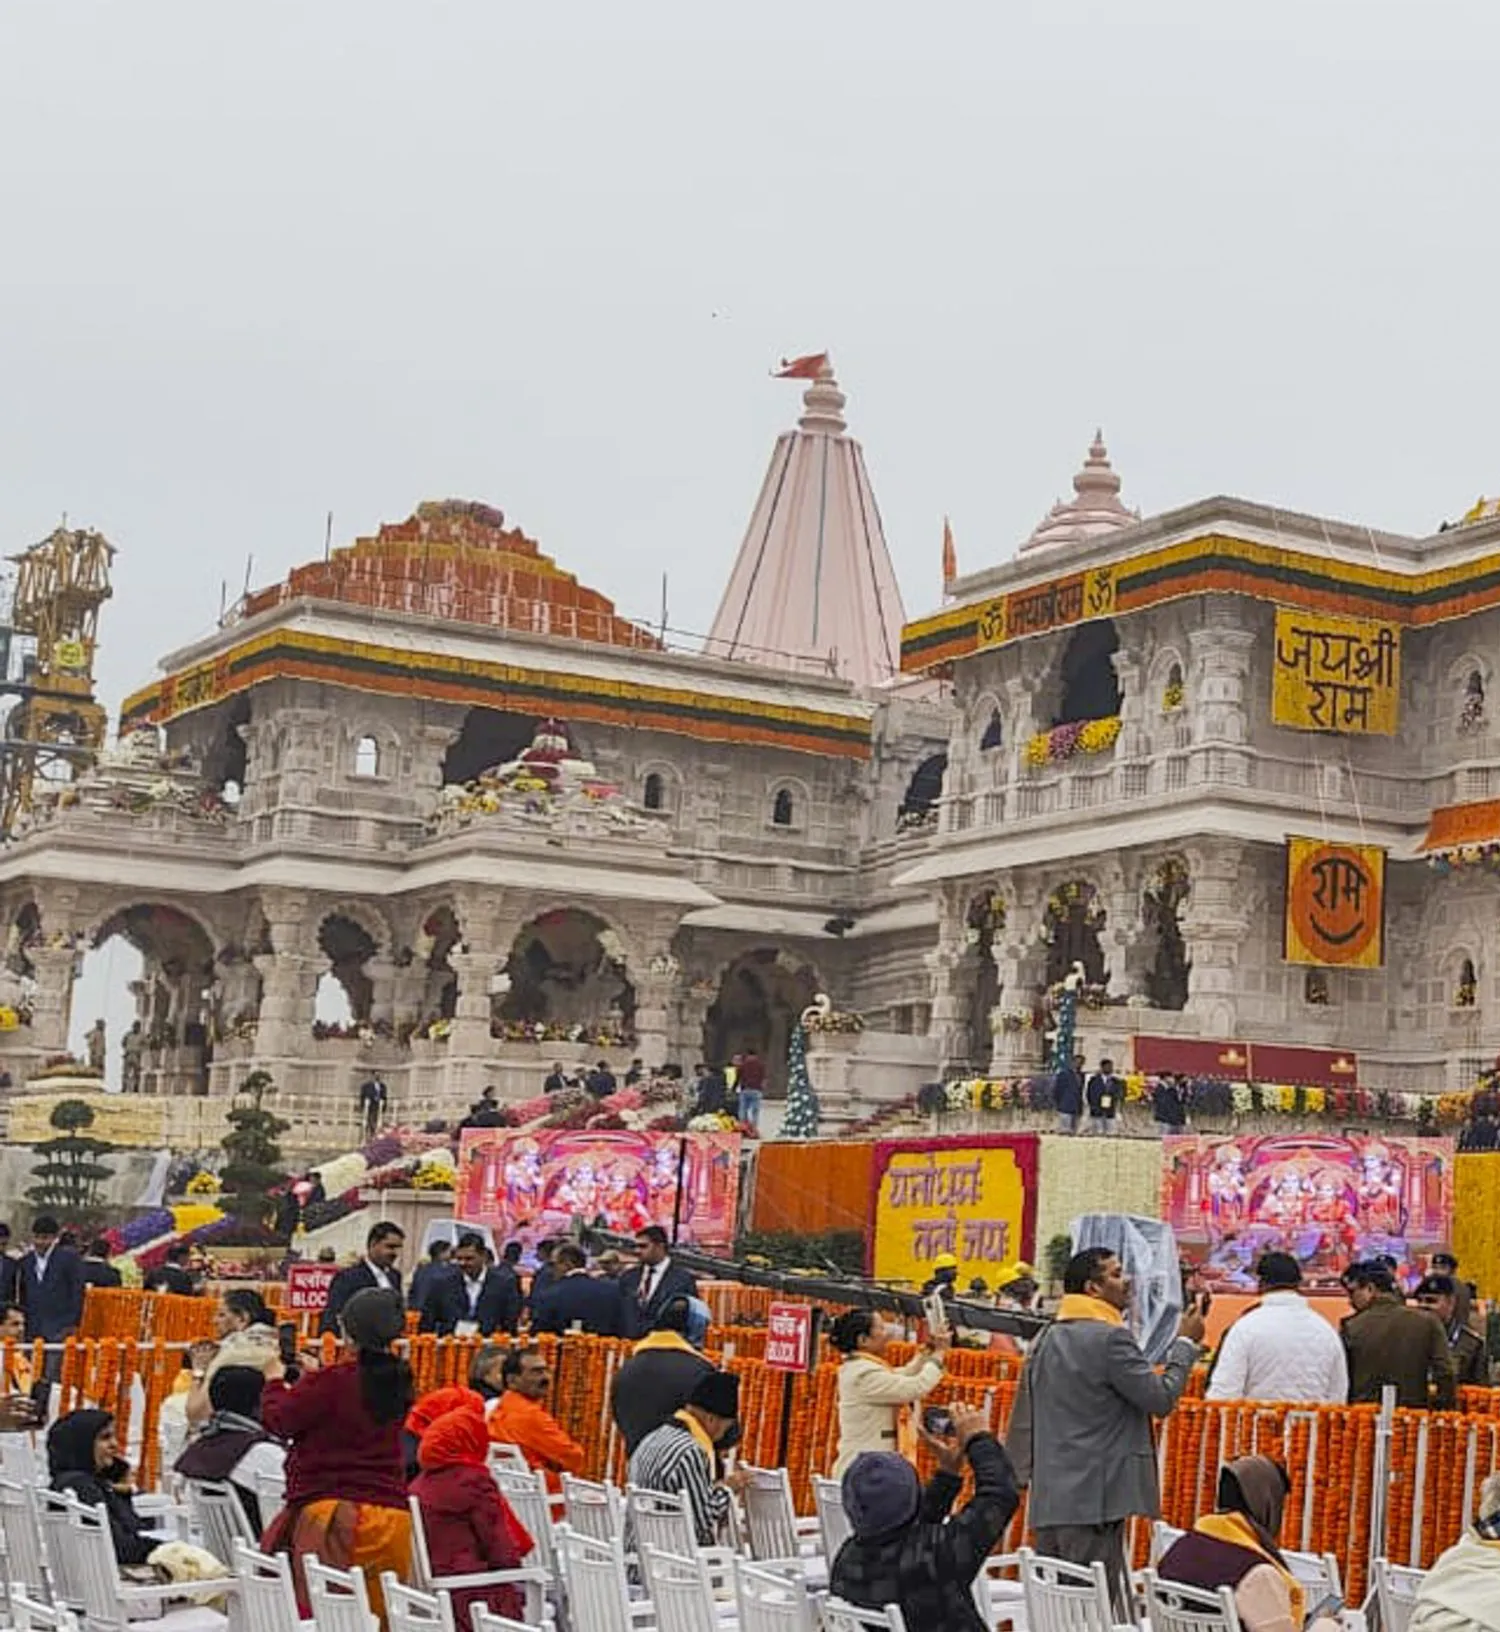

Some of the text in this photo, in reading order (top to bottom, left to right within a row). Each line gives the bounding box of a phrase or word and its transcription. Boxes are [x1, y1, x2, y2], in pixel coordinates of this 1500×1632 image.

[1305, 680, 1374, 730] राम
[1311, 857, 1369, 912] राम
[291, 1291, 329, 1308] BLOC
